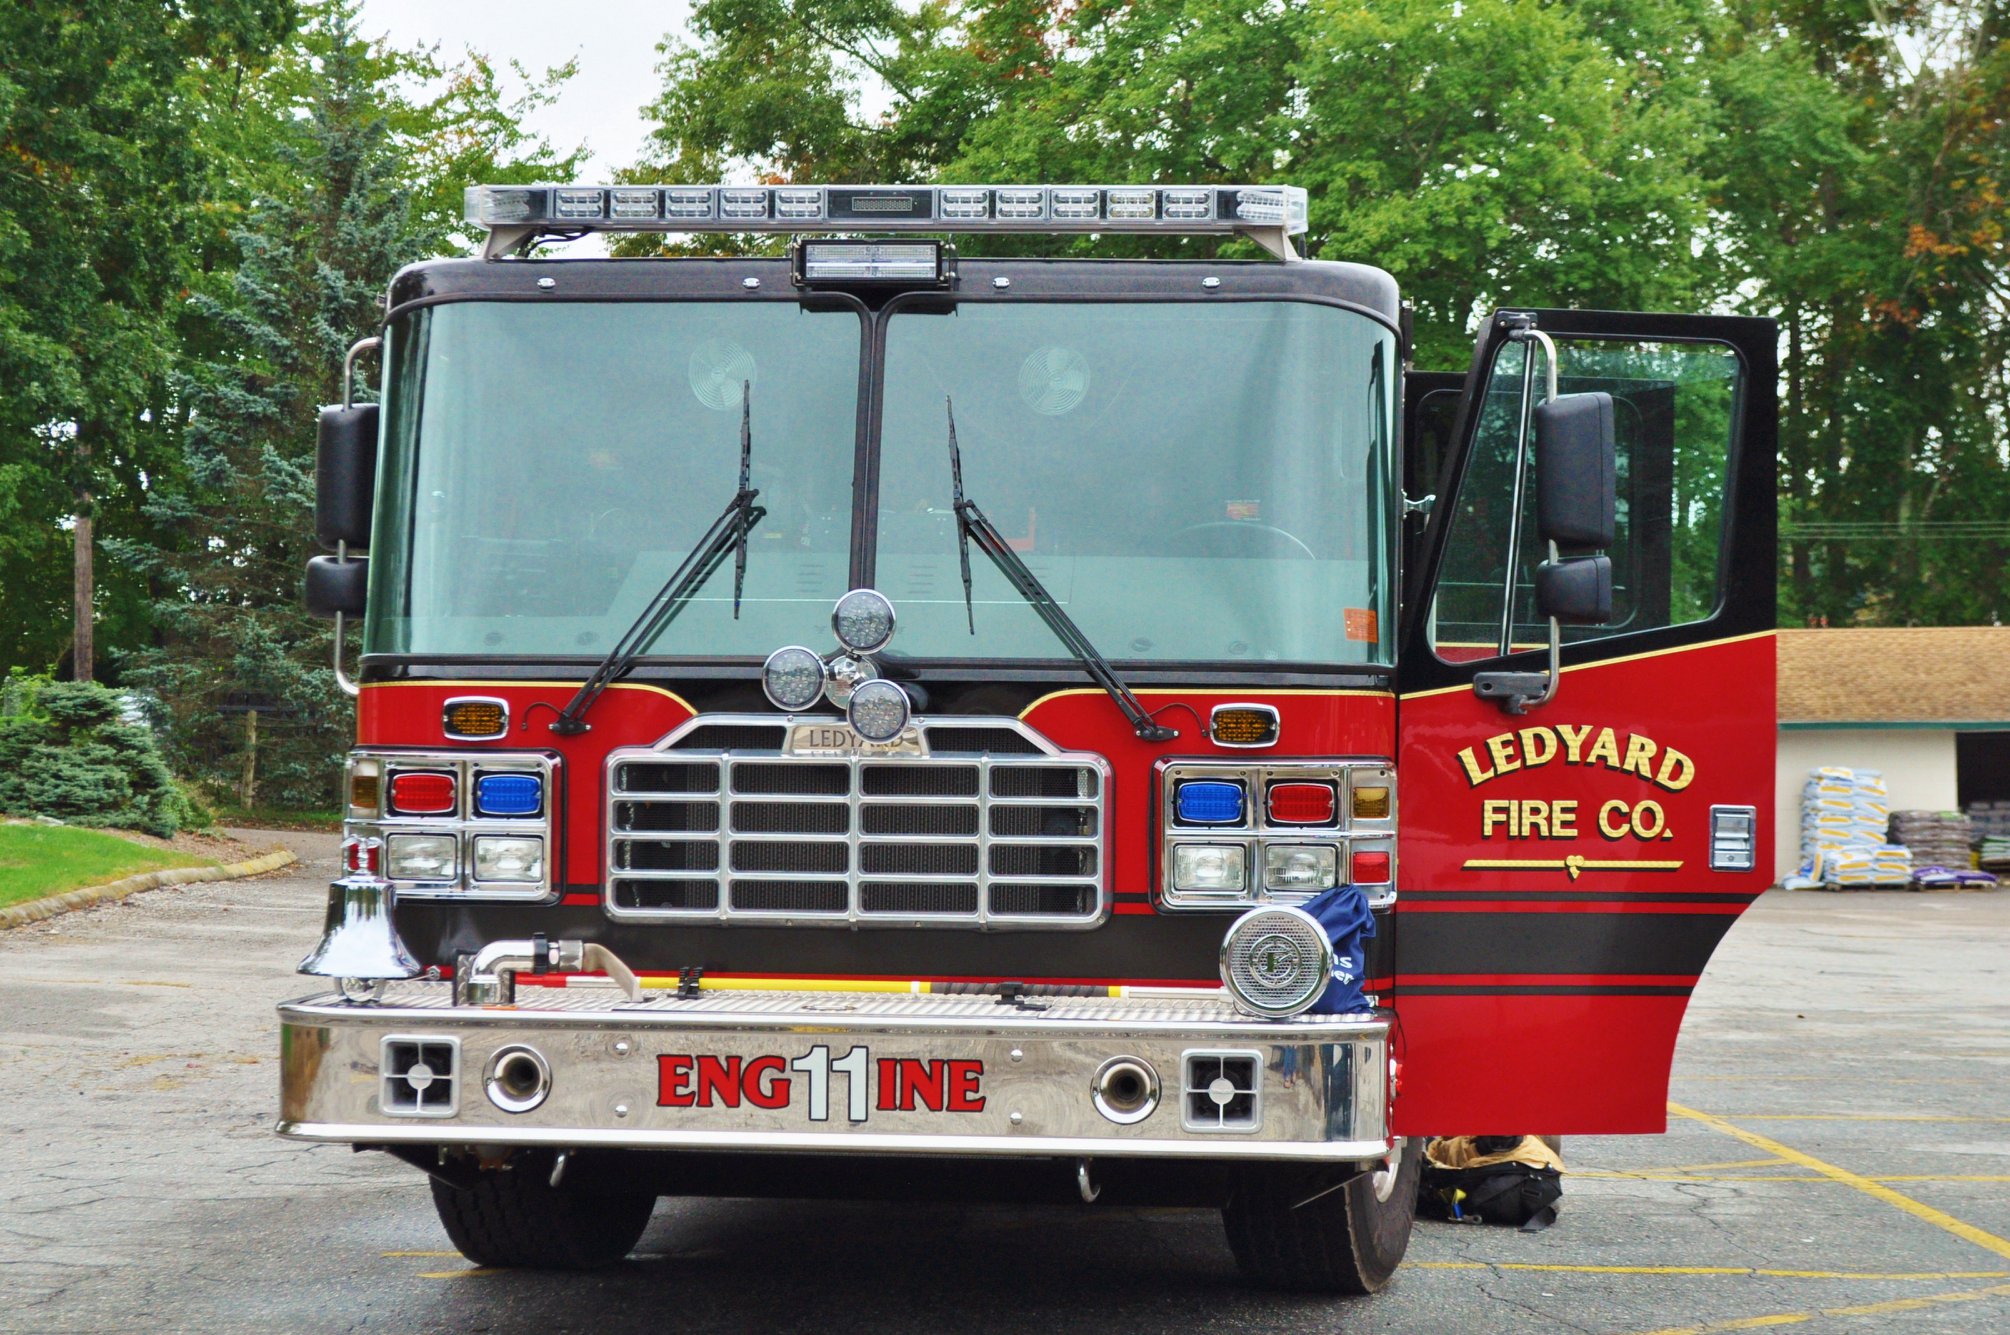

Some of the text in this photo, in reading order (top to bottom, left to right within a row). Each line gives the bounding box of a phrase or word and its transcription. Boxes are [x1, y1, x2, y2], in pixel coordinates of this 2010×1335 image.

[810, 729, 904, 748] LEDY
[1456, 724, 1695, 792] LEDYARD
[1482, 799, 1674, 841] FIRE CO.
